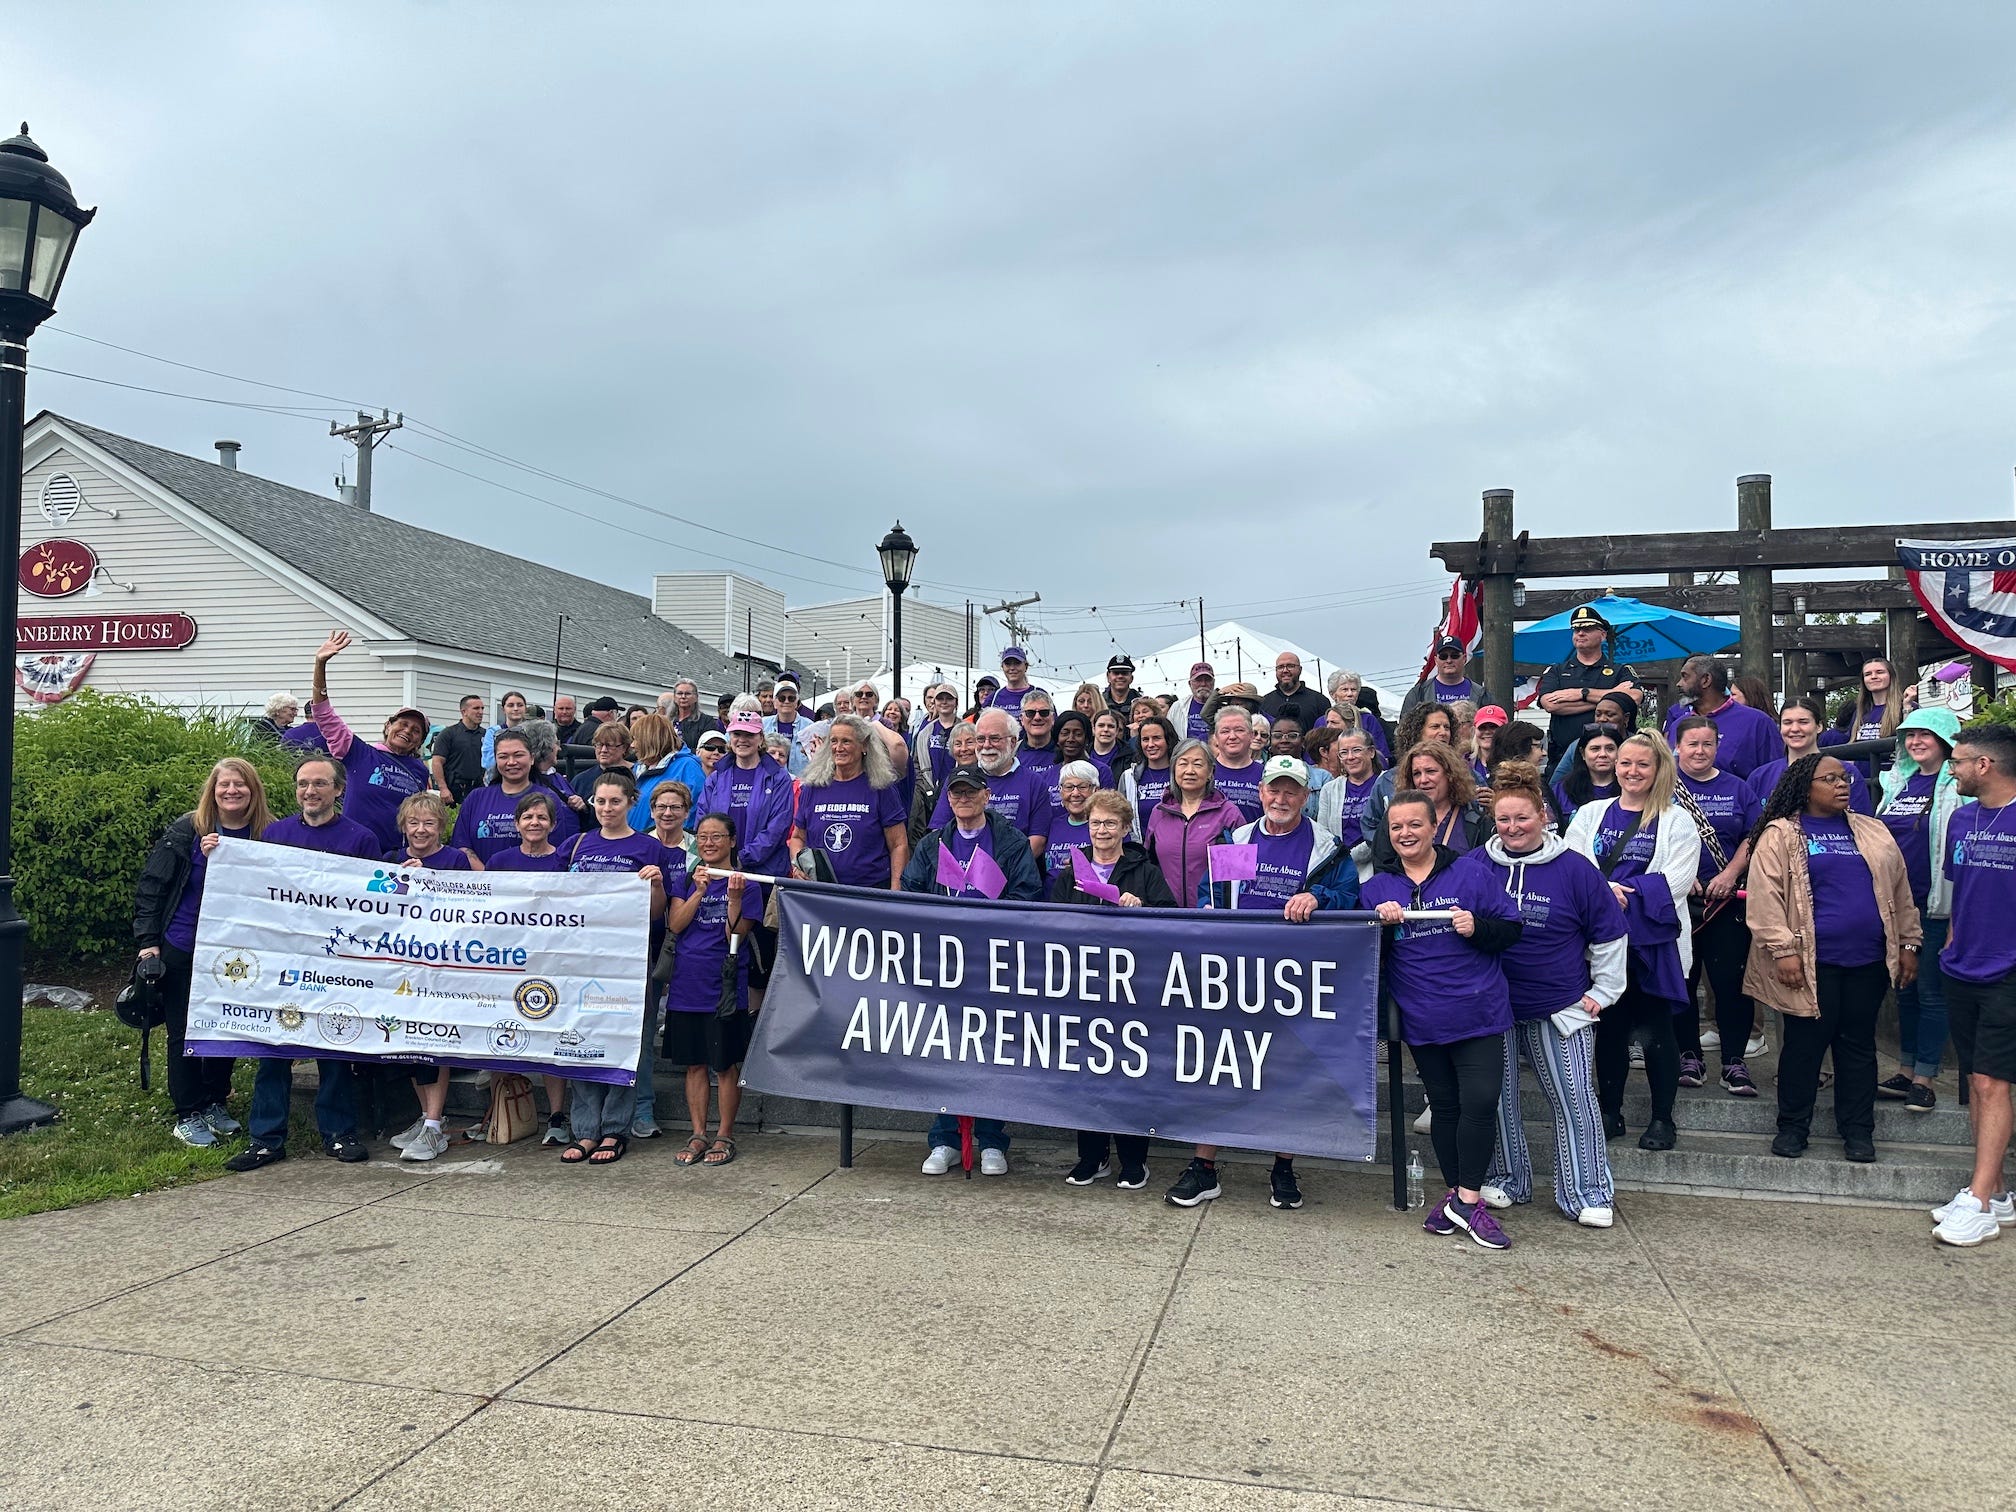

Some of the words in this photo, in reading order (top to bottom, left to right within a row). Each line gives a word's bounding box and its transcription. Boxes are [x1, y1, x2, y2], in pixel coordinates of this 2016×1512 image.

[1920, 552, 1990, 567] HOME
[15, 625, 95, 643] ANBERRY
[100, 620, 172, 644] HOUSE
[1442, 636, 1453, 646] P
[612, 855, 634, 865] Abuse
[1260, 863, 1279, 874] Elder
[1279, 865, 1302, 877] Abuse
[466, 883, 492, 891] ABUSE
[1400, 902, 1411, 911] nd
[1435, 896, 1459, 908] Abuse
[1508, 890, 1523, 900] lder
[1525, 890, 1551, 904] Abuse
[267, 886, 338, 909] THANK
[345, 898, 389, 915] YOU
[398, 903, 422, 919] TO
[430, 908, 465, 923] OUR
[472, 910, 585, 927] SPONSORS!
[302, 970, 374, 988] Bluestone
[802, 923, 964, 988] WORLD
[989, 938, 1137, 1005] ELDER
[1161, 952, 1337, 1020] ABUSE
[299, 983, 328, 992] BANK
[477, 1001, 497, 1009] Bank
[222, 1003, 272, 1023] Rotary
[194, 1019, 218, 1029] Club
[219, 1019, 229, 1029] of
[231, 1021, 271, 1033] Brockton
[405, 1021, 461, 1039] BCOA
[841, 997, 1149, 1077] AWARENESS
[1176, 1024, 1273, 1090] DAY
